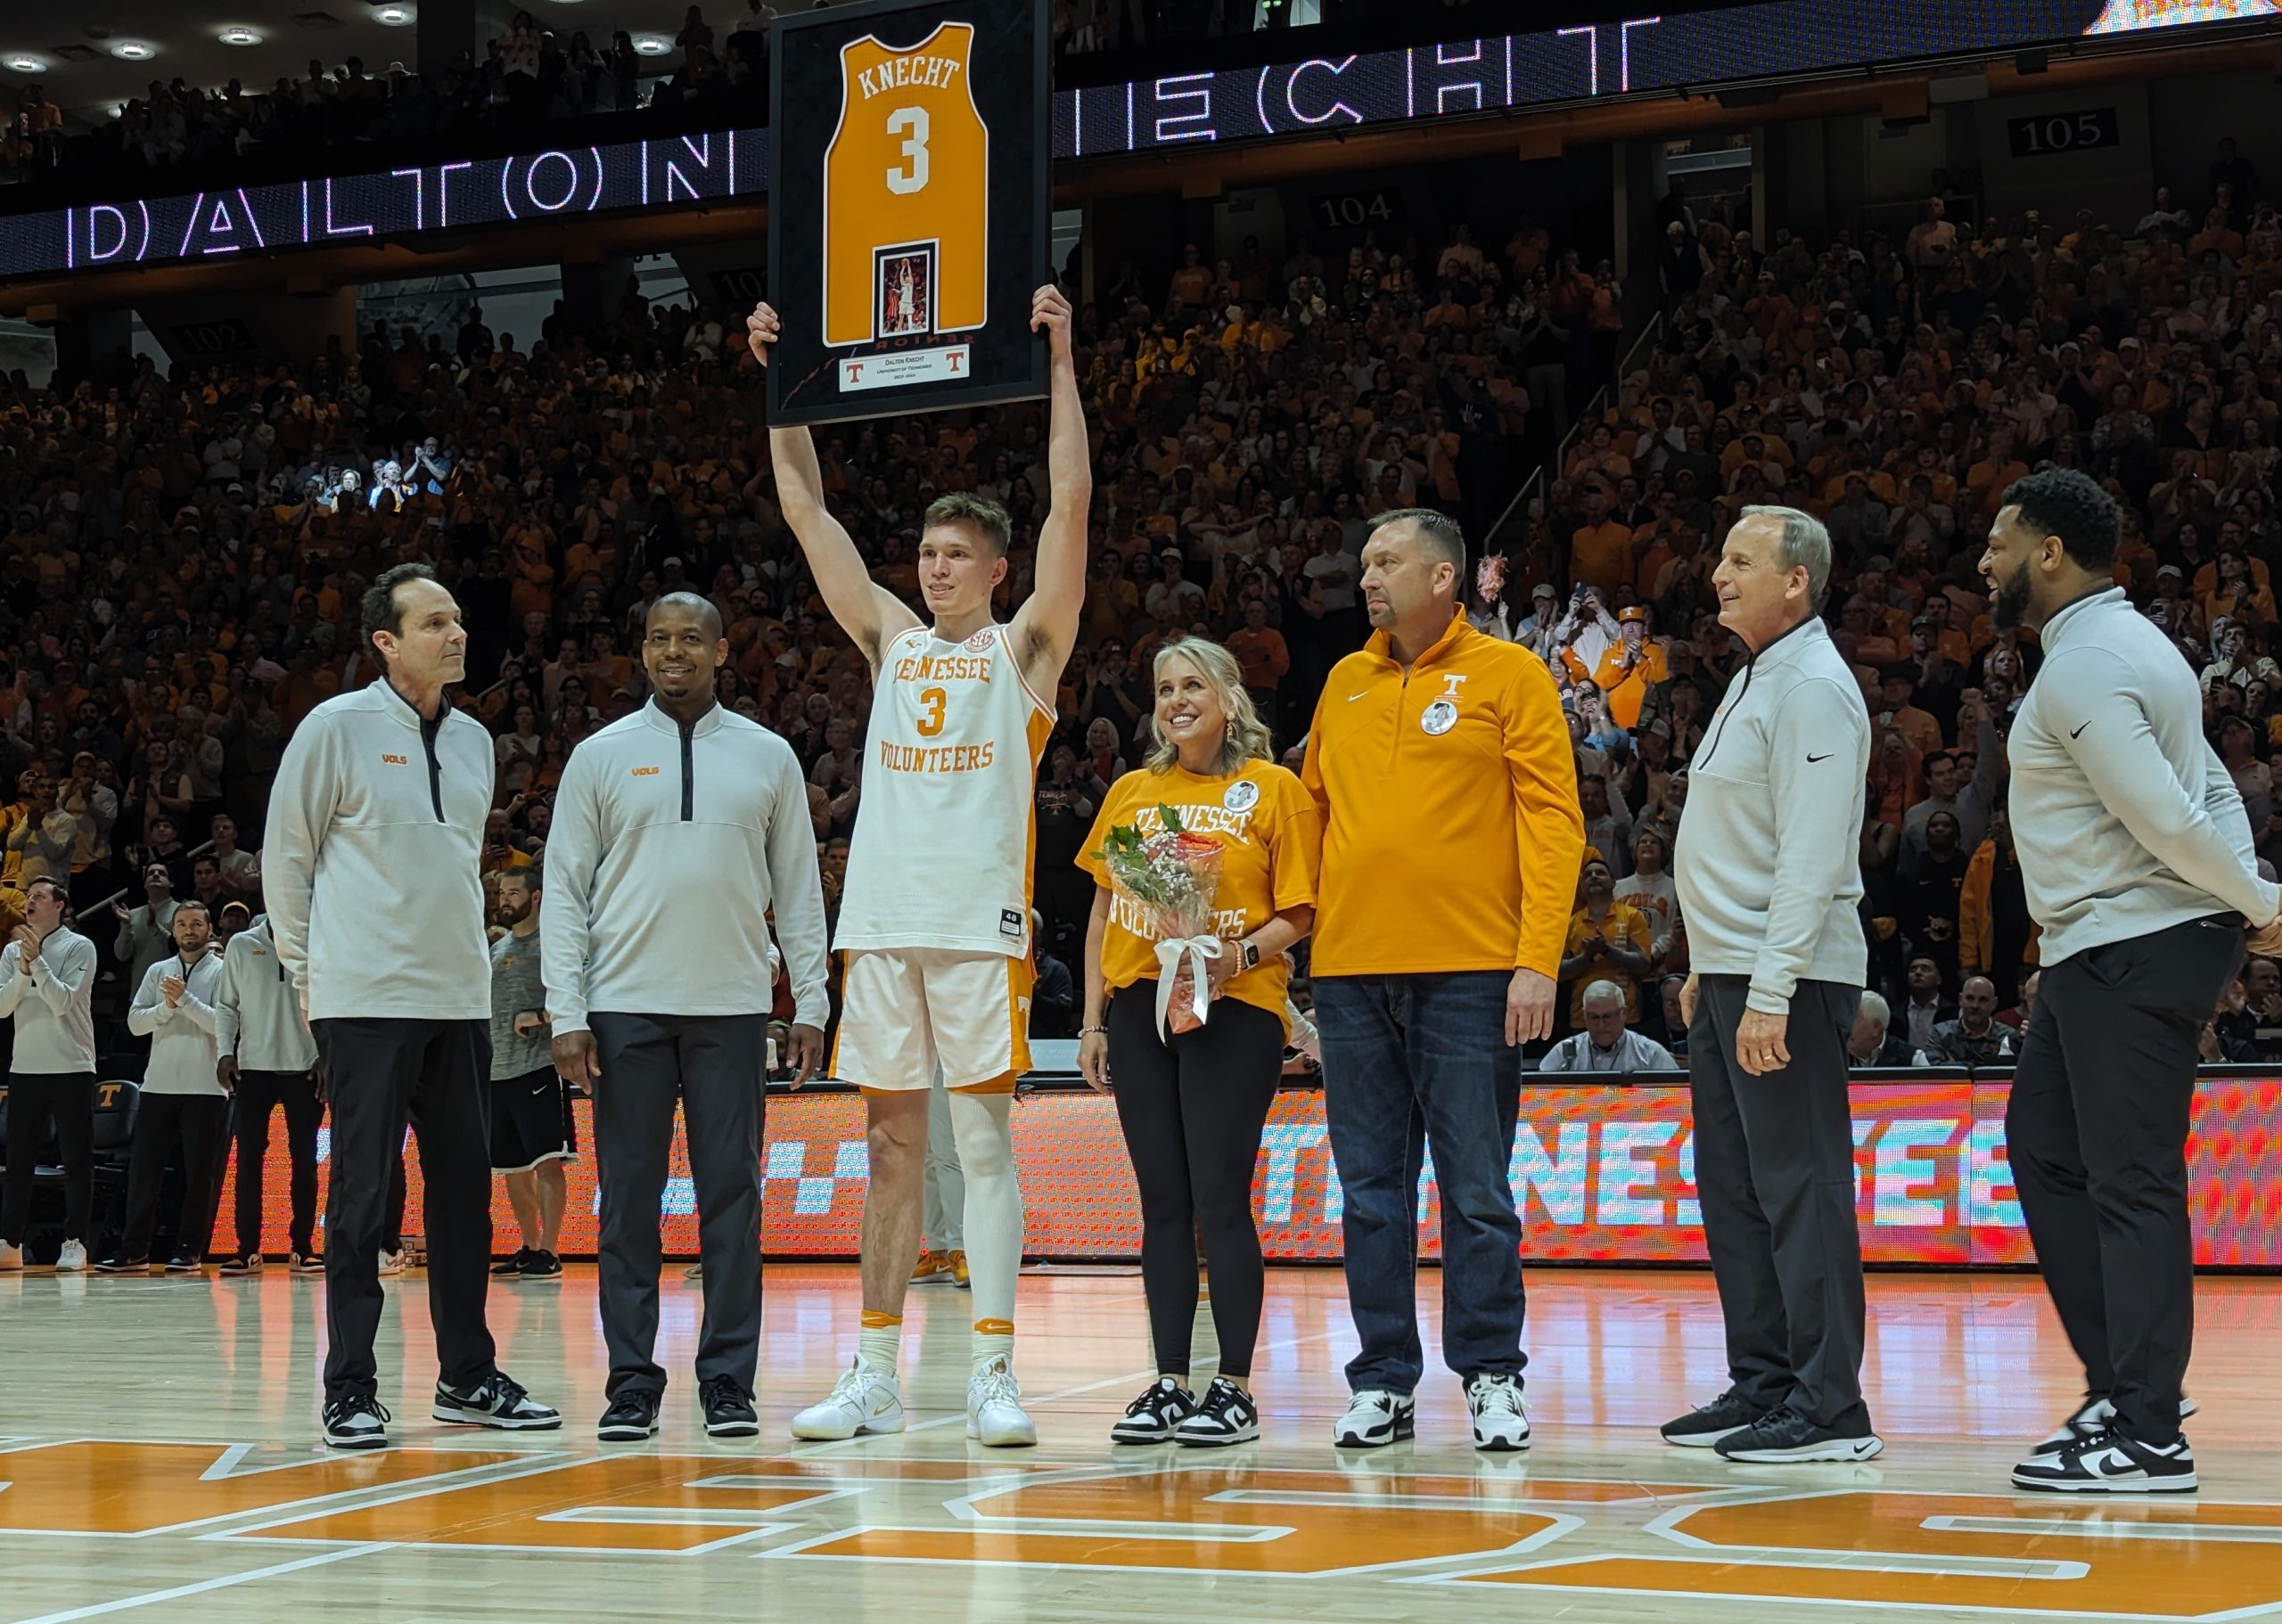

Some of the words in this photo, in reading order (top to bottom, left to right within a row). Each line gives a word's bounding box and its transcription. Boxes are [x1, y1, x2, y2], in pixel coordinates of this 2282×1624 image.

[858, 55, 961, 101] KNECHT
[1075, 16, 1661, 156] ECHT
[2021, 114, 2101, 152] 105
[886, 106, 930, 195] 3
[66, 130, 735, 269] DALTON
[1319, 192, 1393, 227] 104
[721, 271, 768, 300] 10
[182, 324, 247, 352] 102
[846, 364, 864, 383] T
[885, 358, 905, 366] DALTON
[905, 356, 925, 364] KNECHT
[946, 352, 965, 372] T
[972, 631, 993, 646] SEC
[1443, 674, 1467, 695] T
[916, 687, 947, 737] 3
[382, 753, 407, 765] VOLS
[881, 740, 995, 773] VOLUNTEERS
[631, 767, 660, 776] VOLS
[1006, 913, 1017, 923] 48
[99, 1084, 122, 1107] T
